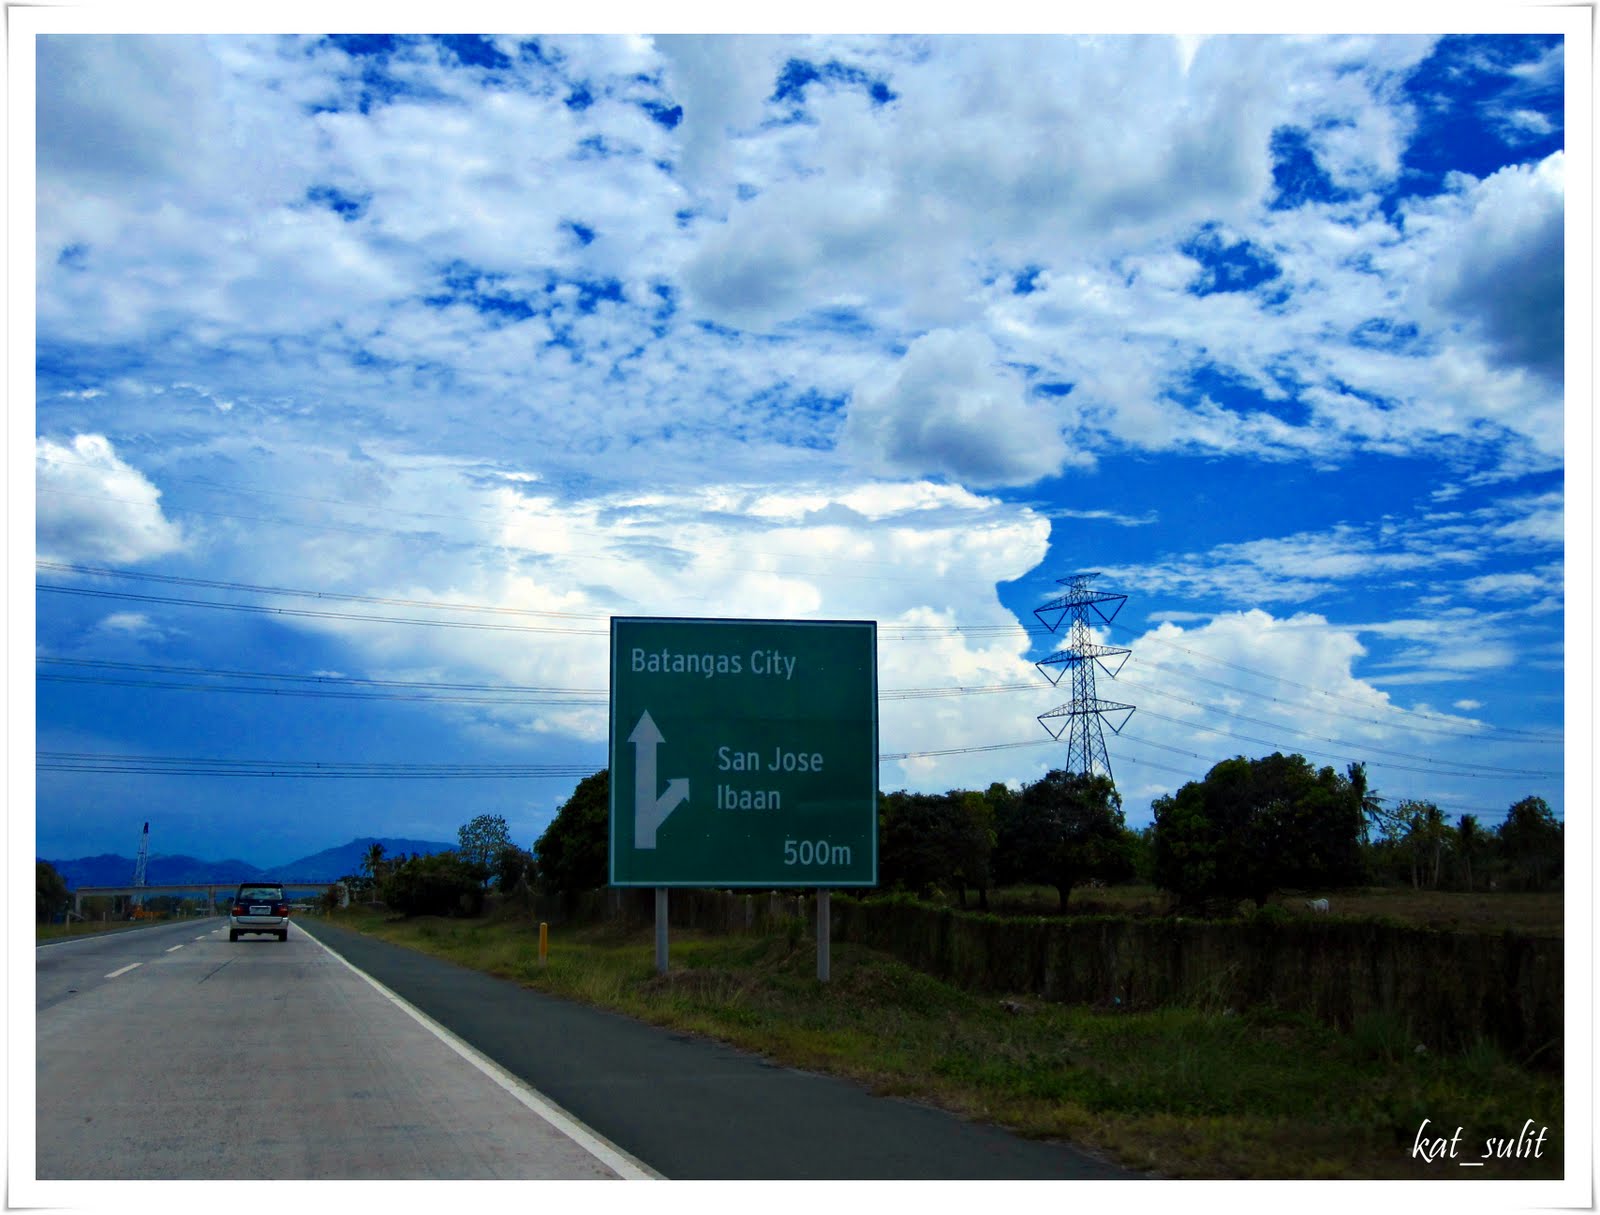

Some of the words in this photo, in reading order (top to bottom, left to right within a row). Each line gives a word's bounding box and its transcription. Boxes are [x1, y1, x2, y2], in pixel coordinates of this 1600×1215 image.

[631, 648, 742, 679] Batangas
[750, 649, 796, 680] City
[718, 746, 760, 771] San
[768, 747, 824, 772] Jose
[717, 784, 781, 810] Ibaan
[784, 840, 851, 865] 500m
